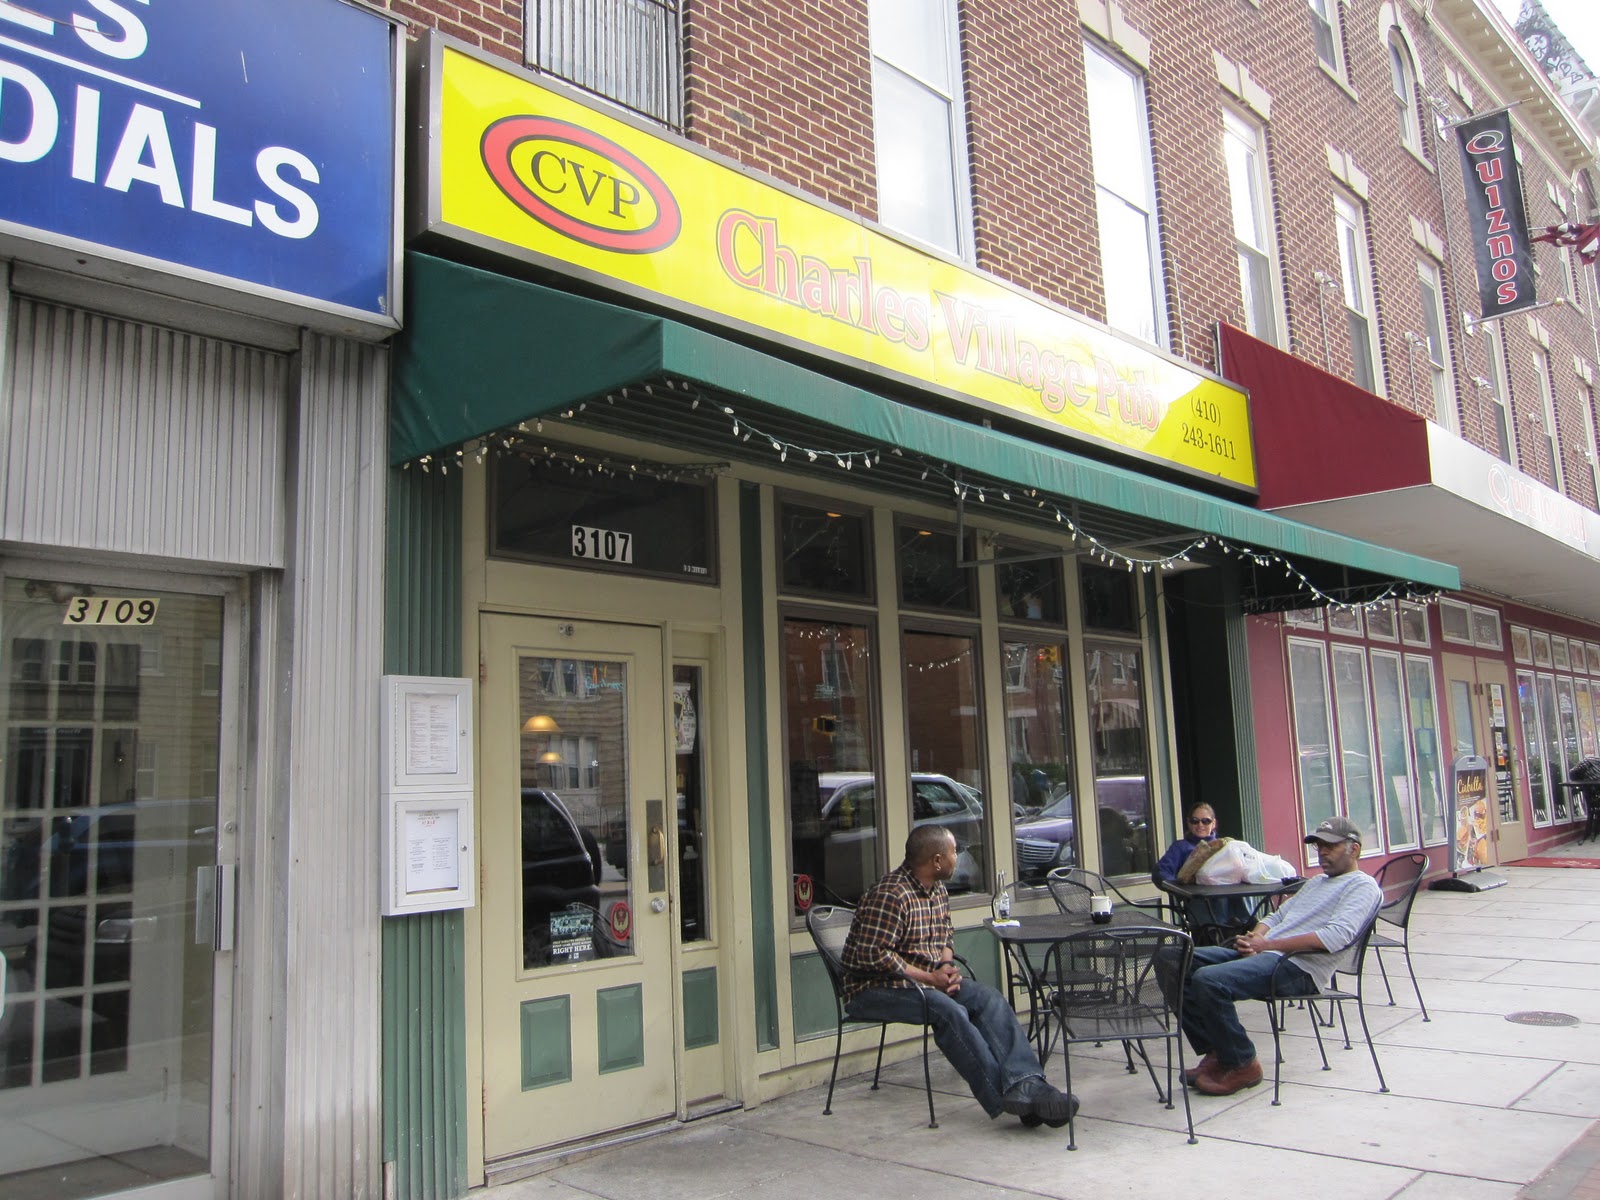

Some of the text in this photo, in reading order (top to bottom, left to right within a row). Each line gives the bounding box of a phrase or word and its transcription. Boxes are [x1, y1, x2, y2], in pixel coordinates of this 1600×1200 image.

[530, 150, 640, 219] CVP
[1466, 130, 1517, 305] Quiznos
[716, 208, 1160, 433] Charles Village Pub
[1191, 396, 1222, 426] (410)
[1181, 423, 1236, 461] 243-1611
[574, 527, 630, 561] 3107
[69, 599, 155, 624] 3109
[552, 946, 573, 955] RIGHT
